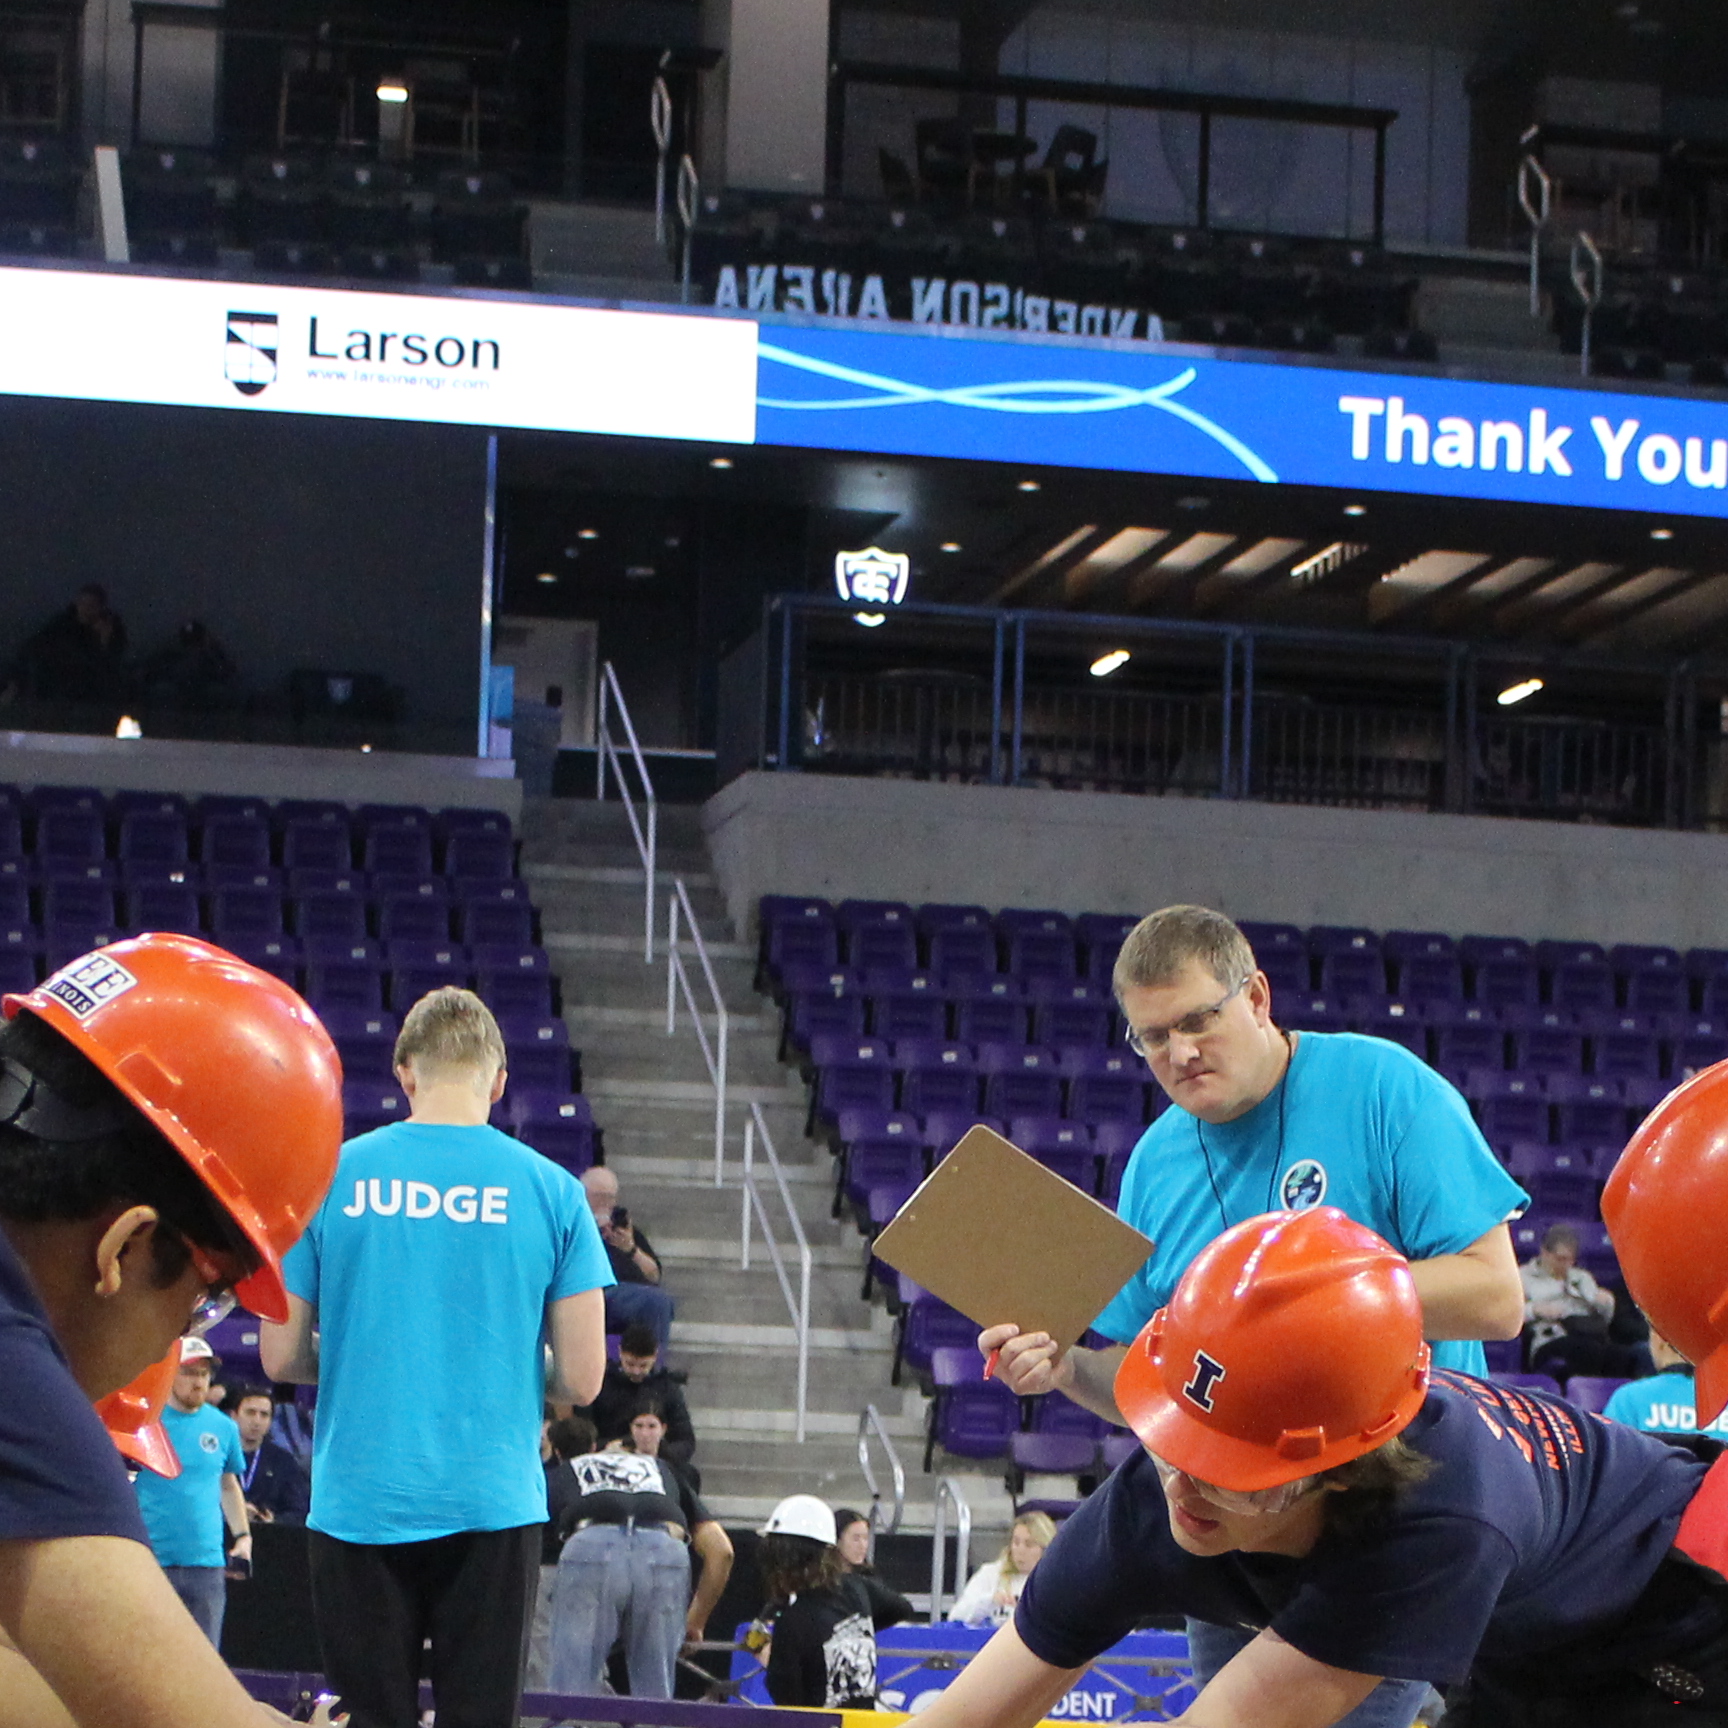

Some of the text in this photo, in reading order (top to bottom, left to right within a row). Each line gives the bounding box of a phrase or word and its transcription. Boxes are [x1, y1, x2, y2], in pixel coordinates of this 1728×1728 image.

[309, 315, 501, 371] Larson
[1338, 396, 1572, 477] Thank
[1590, 417, 1728, 489] You
[343, 1178, 509, 1226] JUDGE
